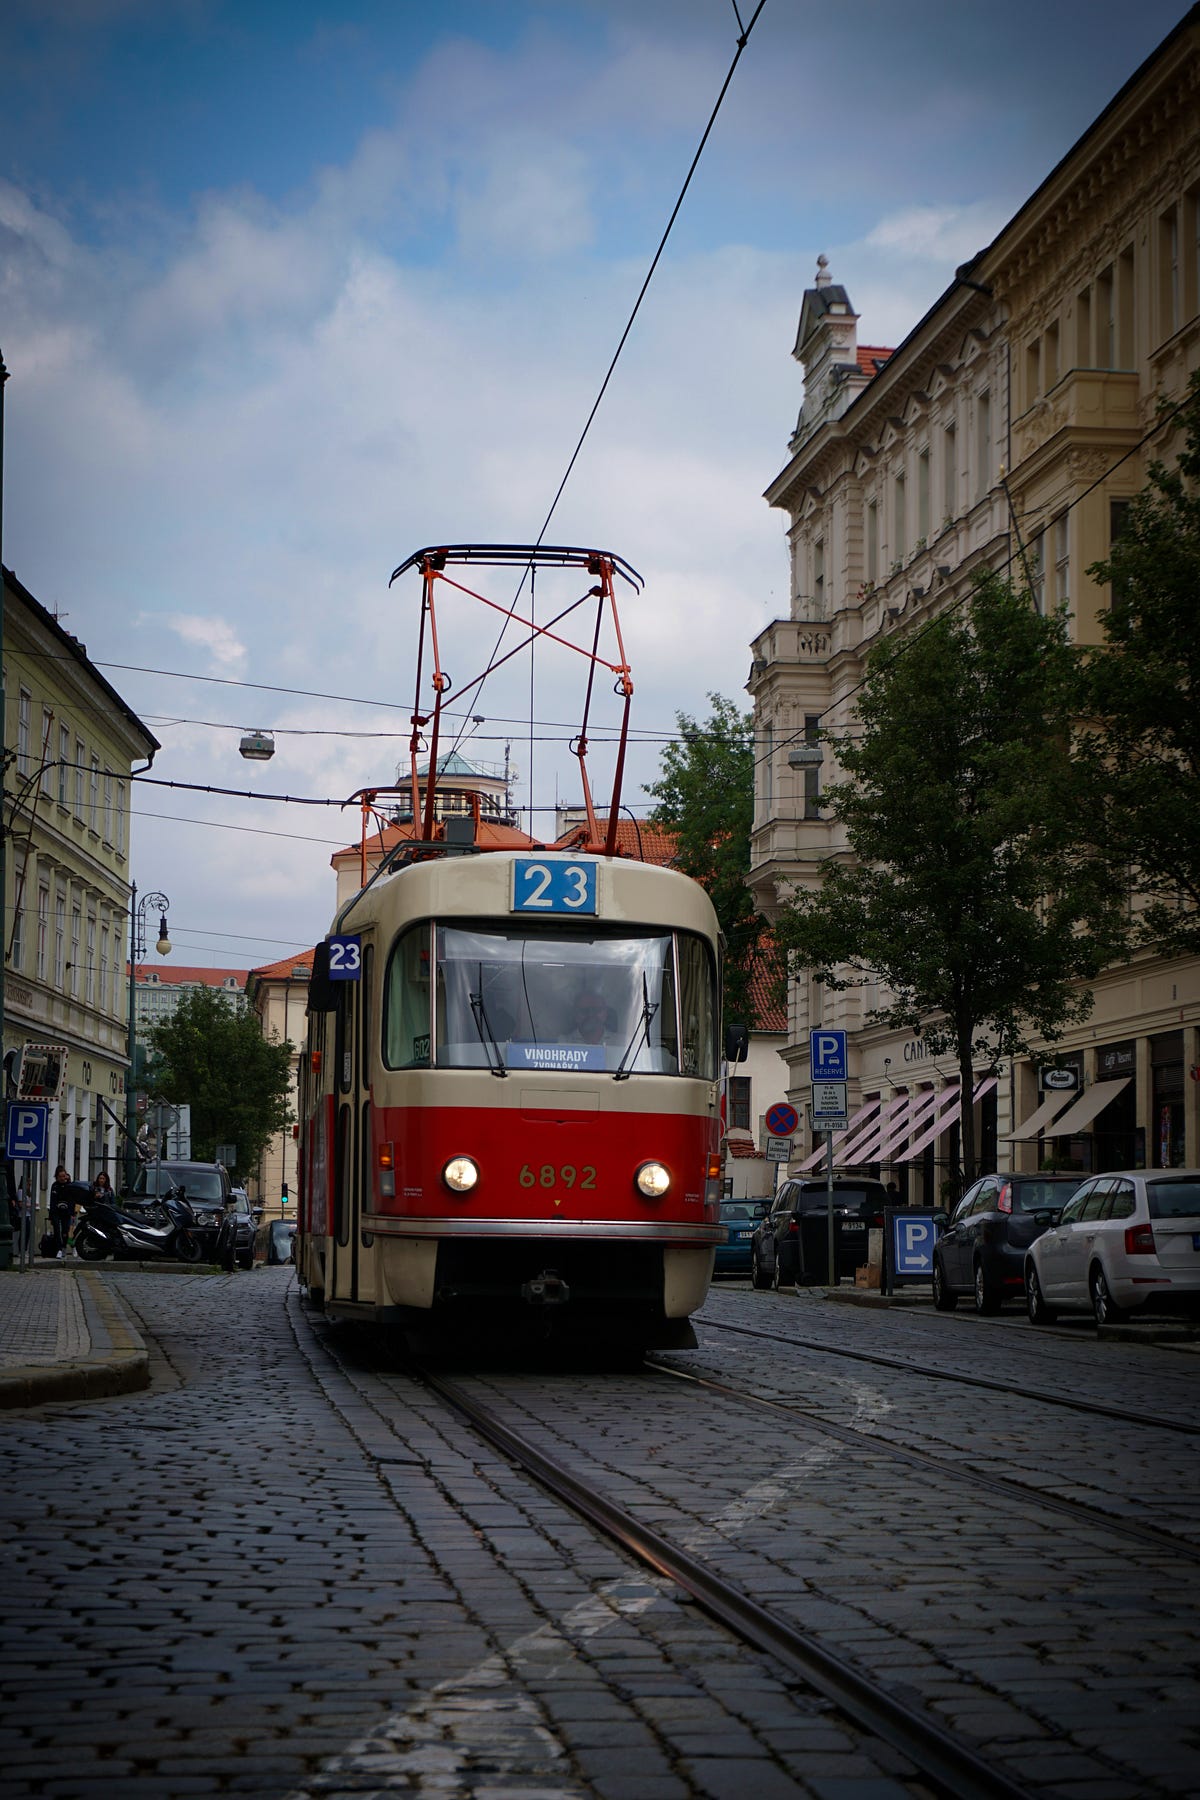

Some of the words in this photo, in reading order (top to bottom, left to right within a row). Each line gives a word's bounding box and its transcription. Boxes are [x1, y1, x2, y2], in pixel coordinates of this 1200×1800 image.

[523, 863, 590, 908] 23
[328, 943, 361, 971] 23
[524, 1048, 589, 1062] VINOHRADY
[818, 1037, 839, 1065] P
[17, 1111, 39, 1136] P
[518, 1165, 599, 1191] 6892
[905, 1224, 928, 1249] P
